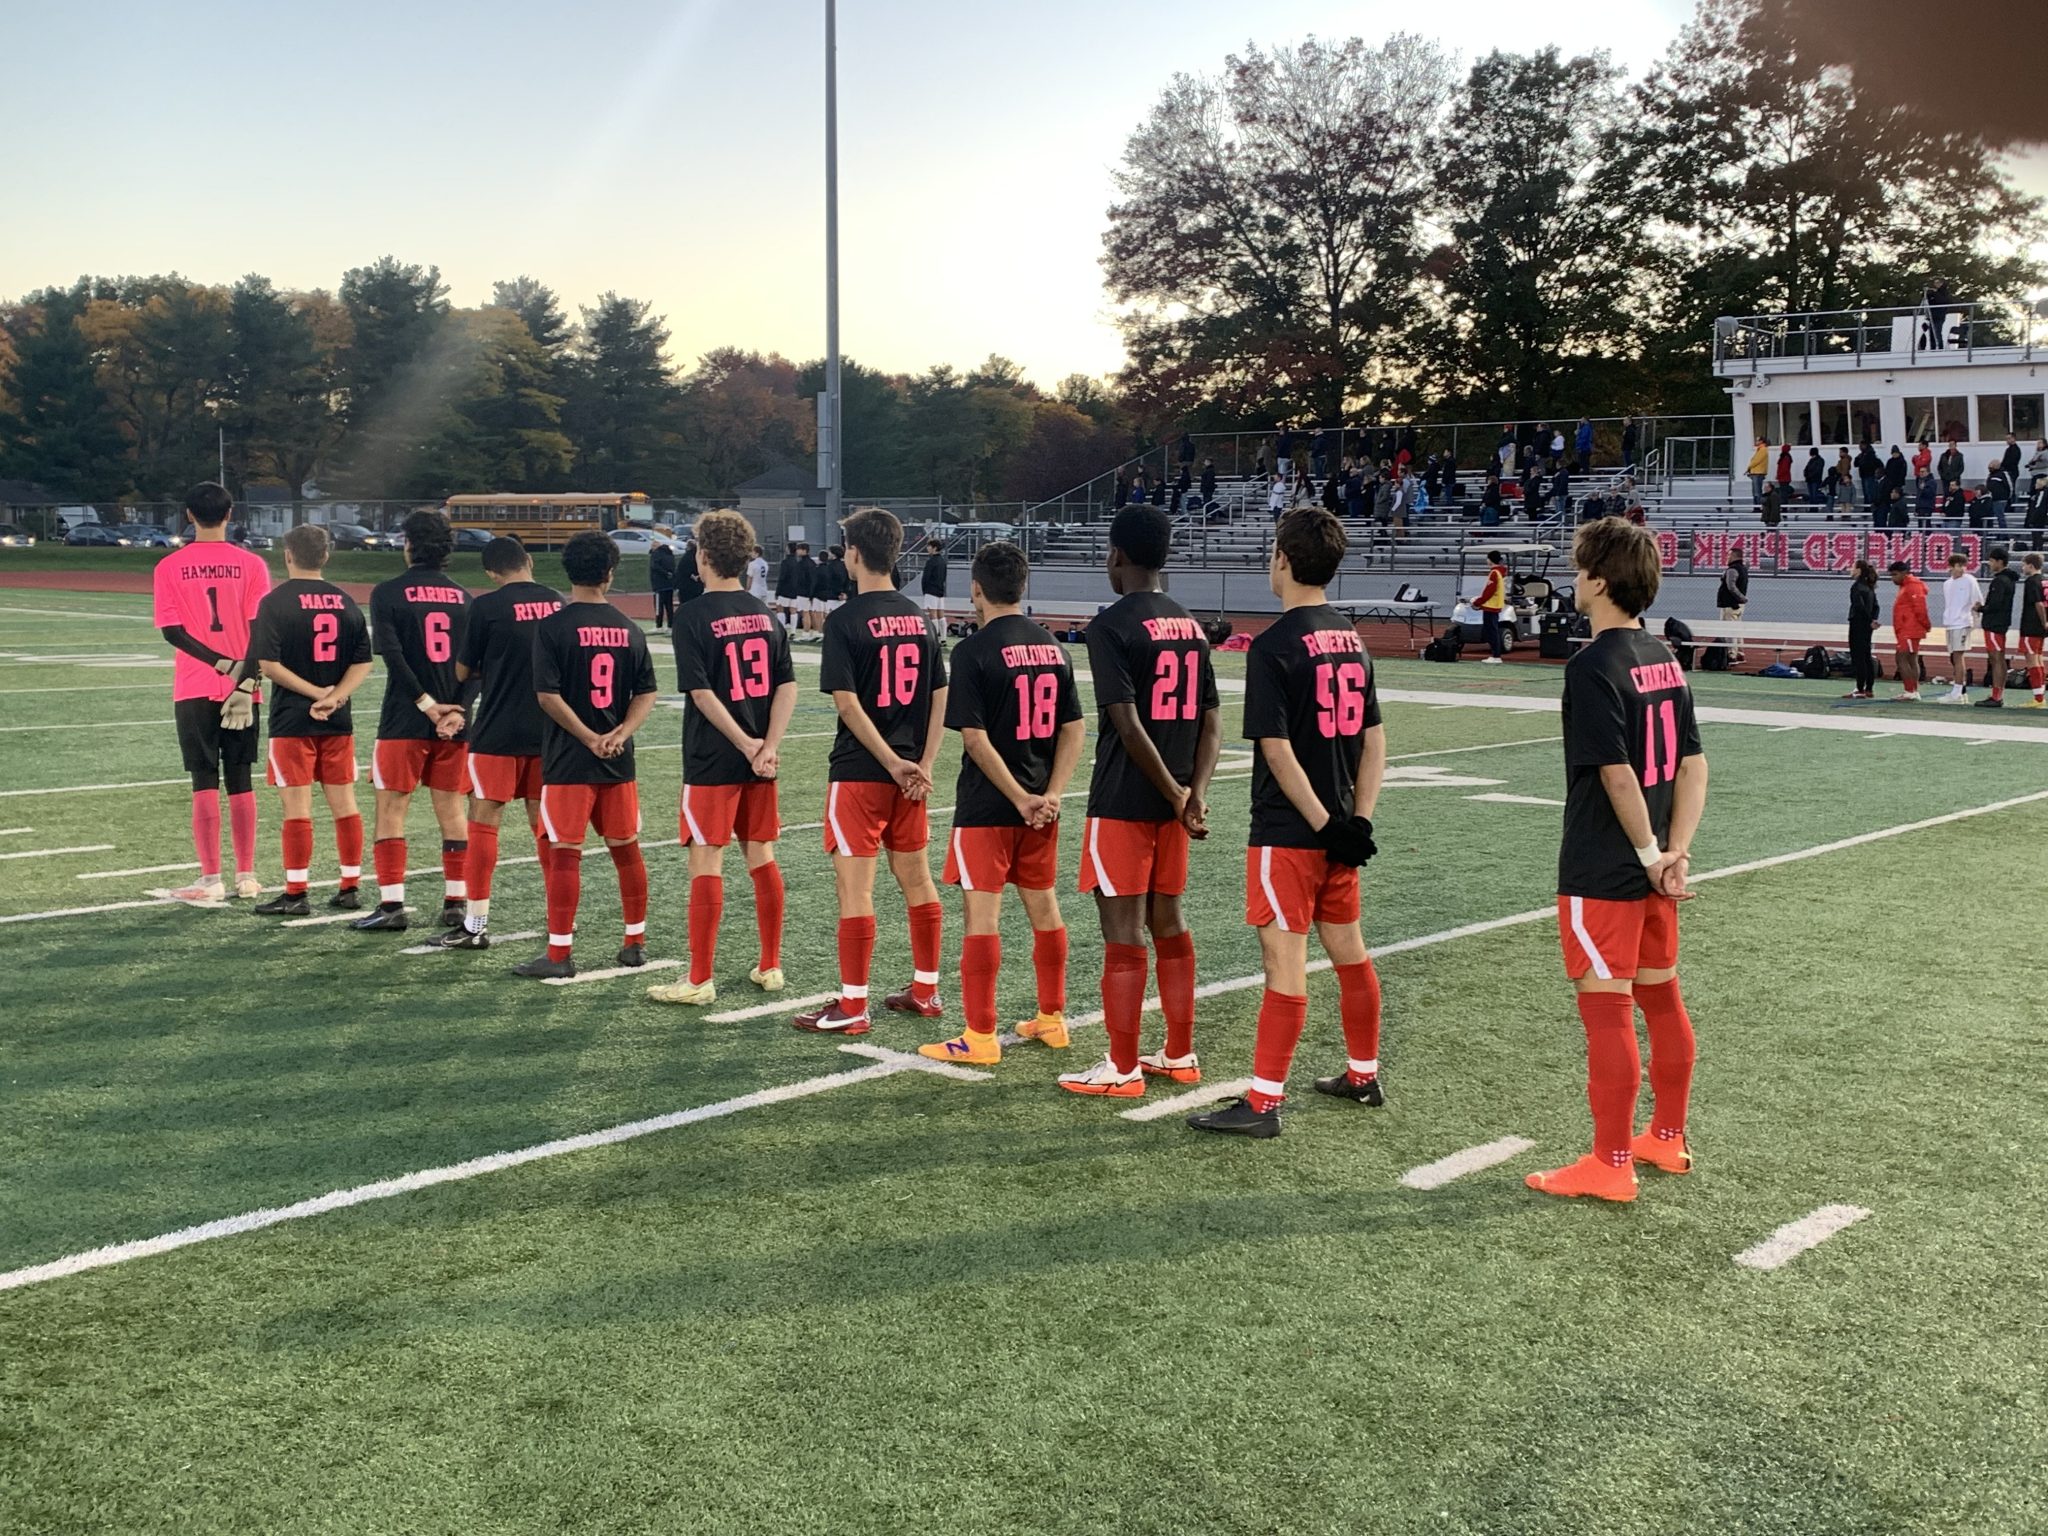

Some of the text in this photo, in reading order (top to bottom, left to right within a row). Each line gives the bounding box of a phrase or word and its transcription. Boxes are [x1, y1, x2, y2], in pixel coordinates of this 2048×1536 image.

[182, 565, 242, 580] HAMMOND
[405, 586, 465, 604] CARNEY
[760, 566, 767, 578] 2
[207, 586, 223, 632] 1
[300, 593, 344, 610] MACK
[313, 613, 338, 662] 2
[425, 612, 451, 663] 6
[577, 627, 629, 647] DRIDI
[867, 616, 927, 638] CAPONE
[1301, 630, 1363, 657] ROBERTS
[590, 653, 615, 709] 9
[725, 637, 770, 702] 13
[877, 643, 920, 707] 16
[1151, 650, 1199, 720] 21
[1015, 673, 1058, 740] 18
[1316, 662, 1365, 738] 56
[1644, 699, 1678, 788] 11
